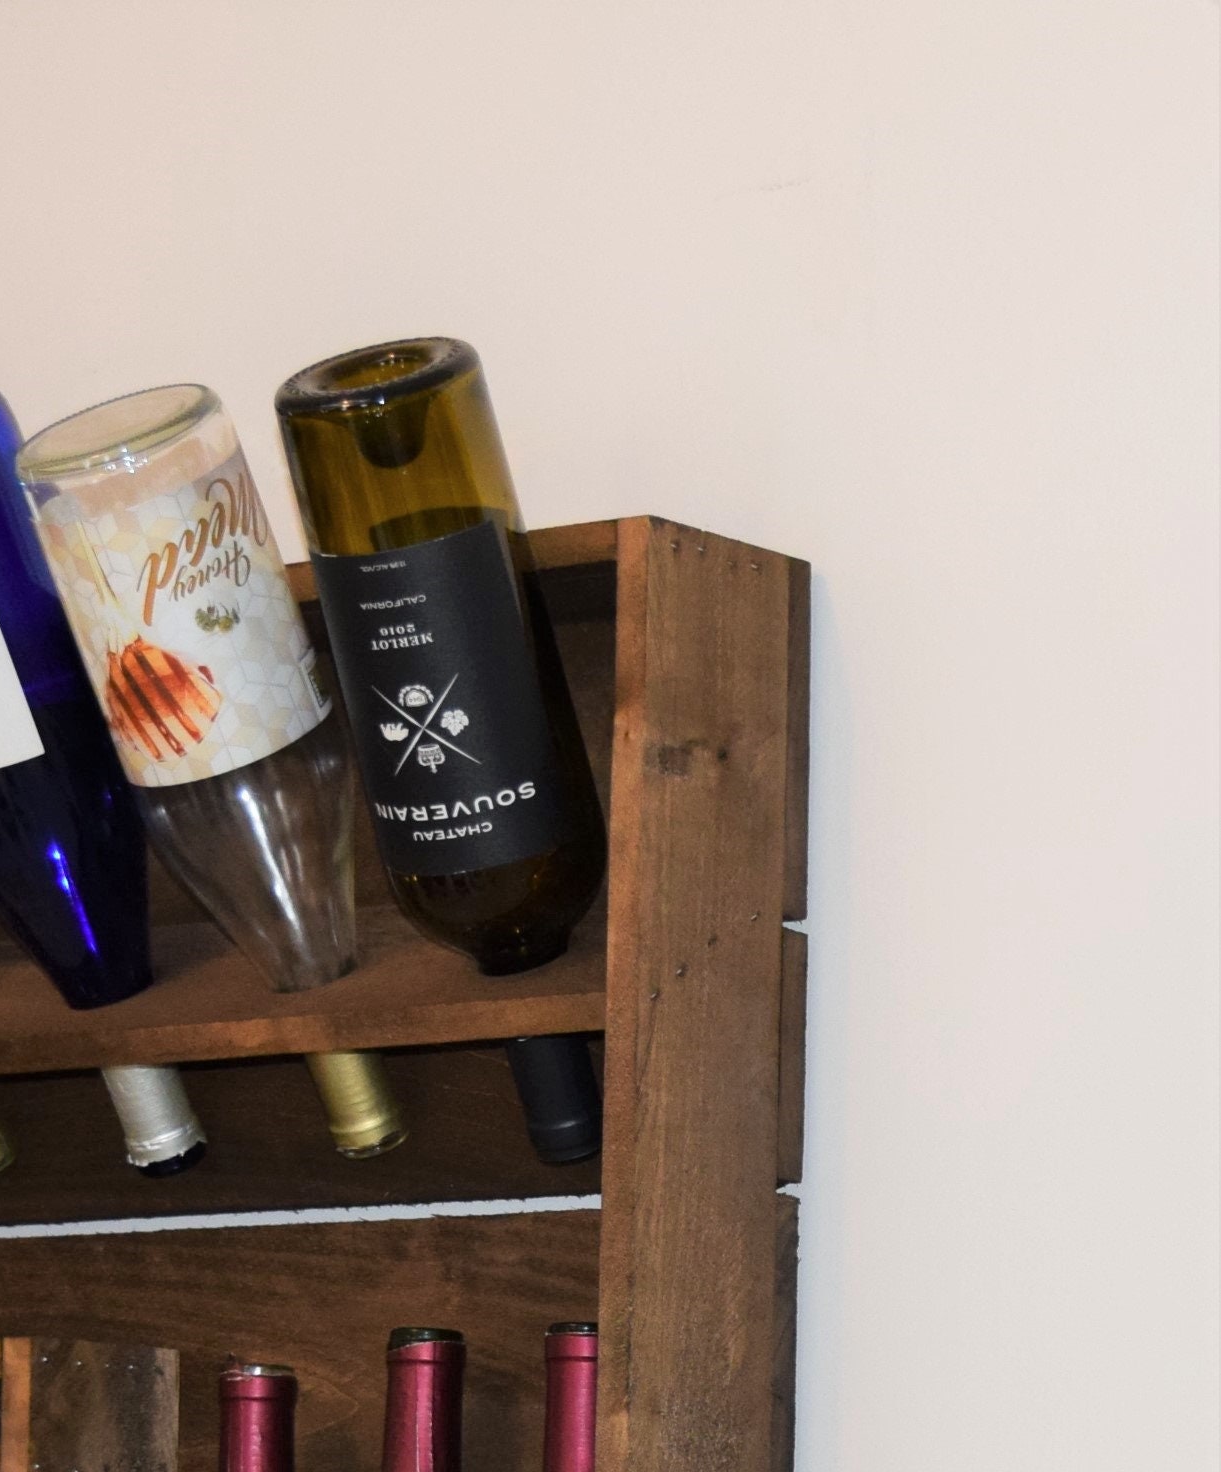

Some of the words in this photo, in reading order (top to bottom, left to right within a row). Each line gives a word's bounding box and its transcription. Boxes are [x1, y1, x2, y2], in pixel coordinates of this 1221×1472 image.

[136, 473, 268, 627] Mead
[169, 541, 251, 601] Honey
[360, 594, 427, 610] CALIFORNIA
[379, 623, 416, 637] 2016
[371, 632, 434, 651] MERLOT
[375, 781, 536, 822] SOUVERAIN
[413, 821, 493, 842] CHATEAU
